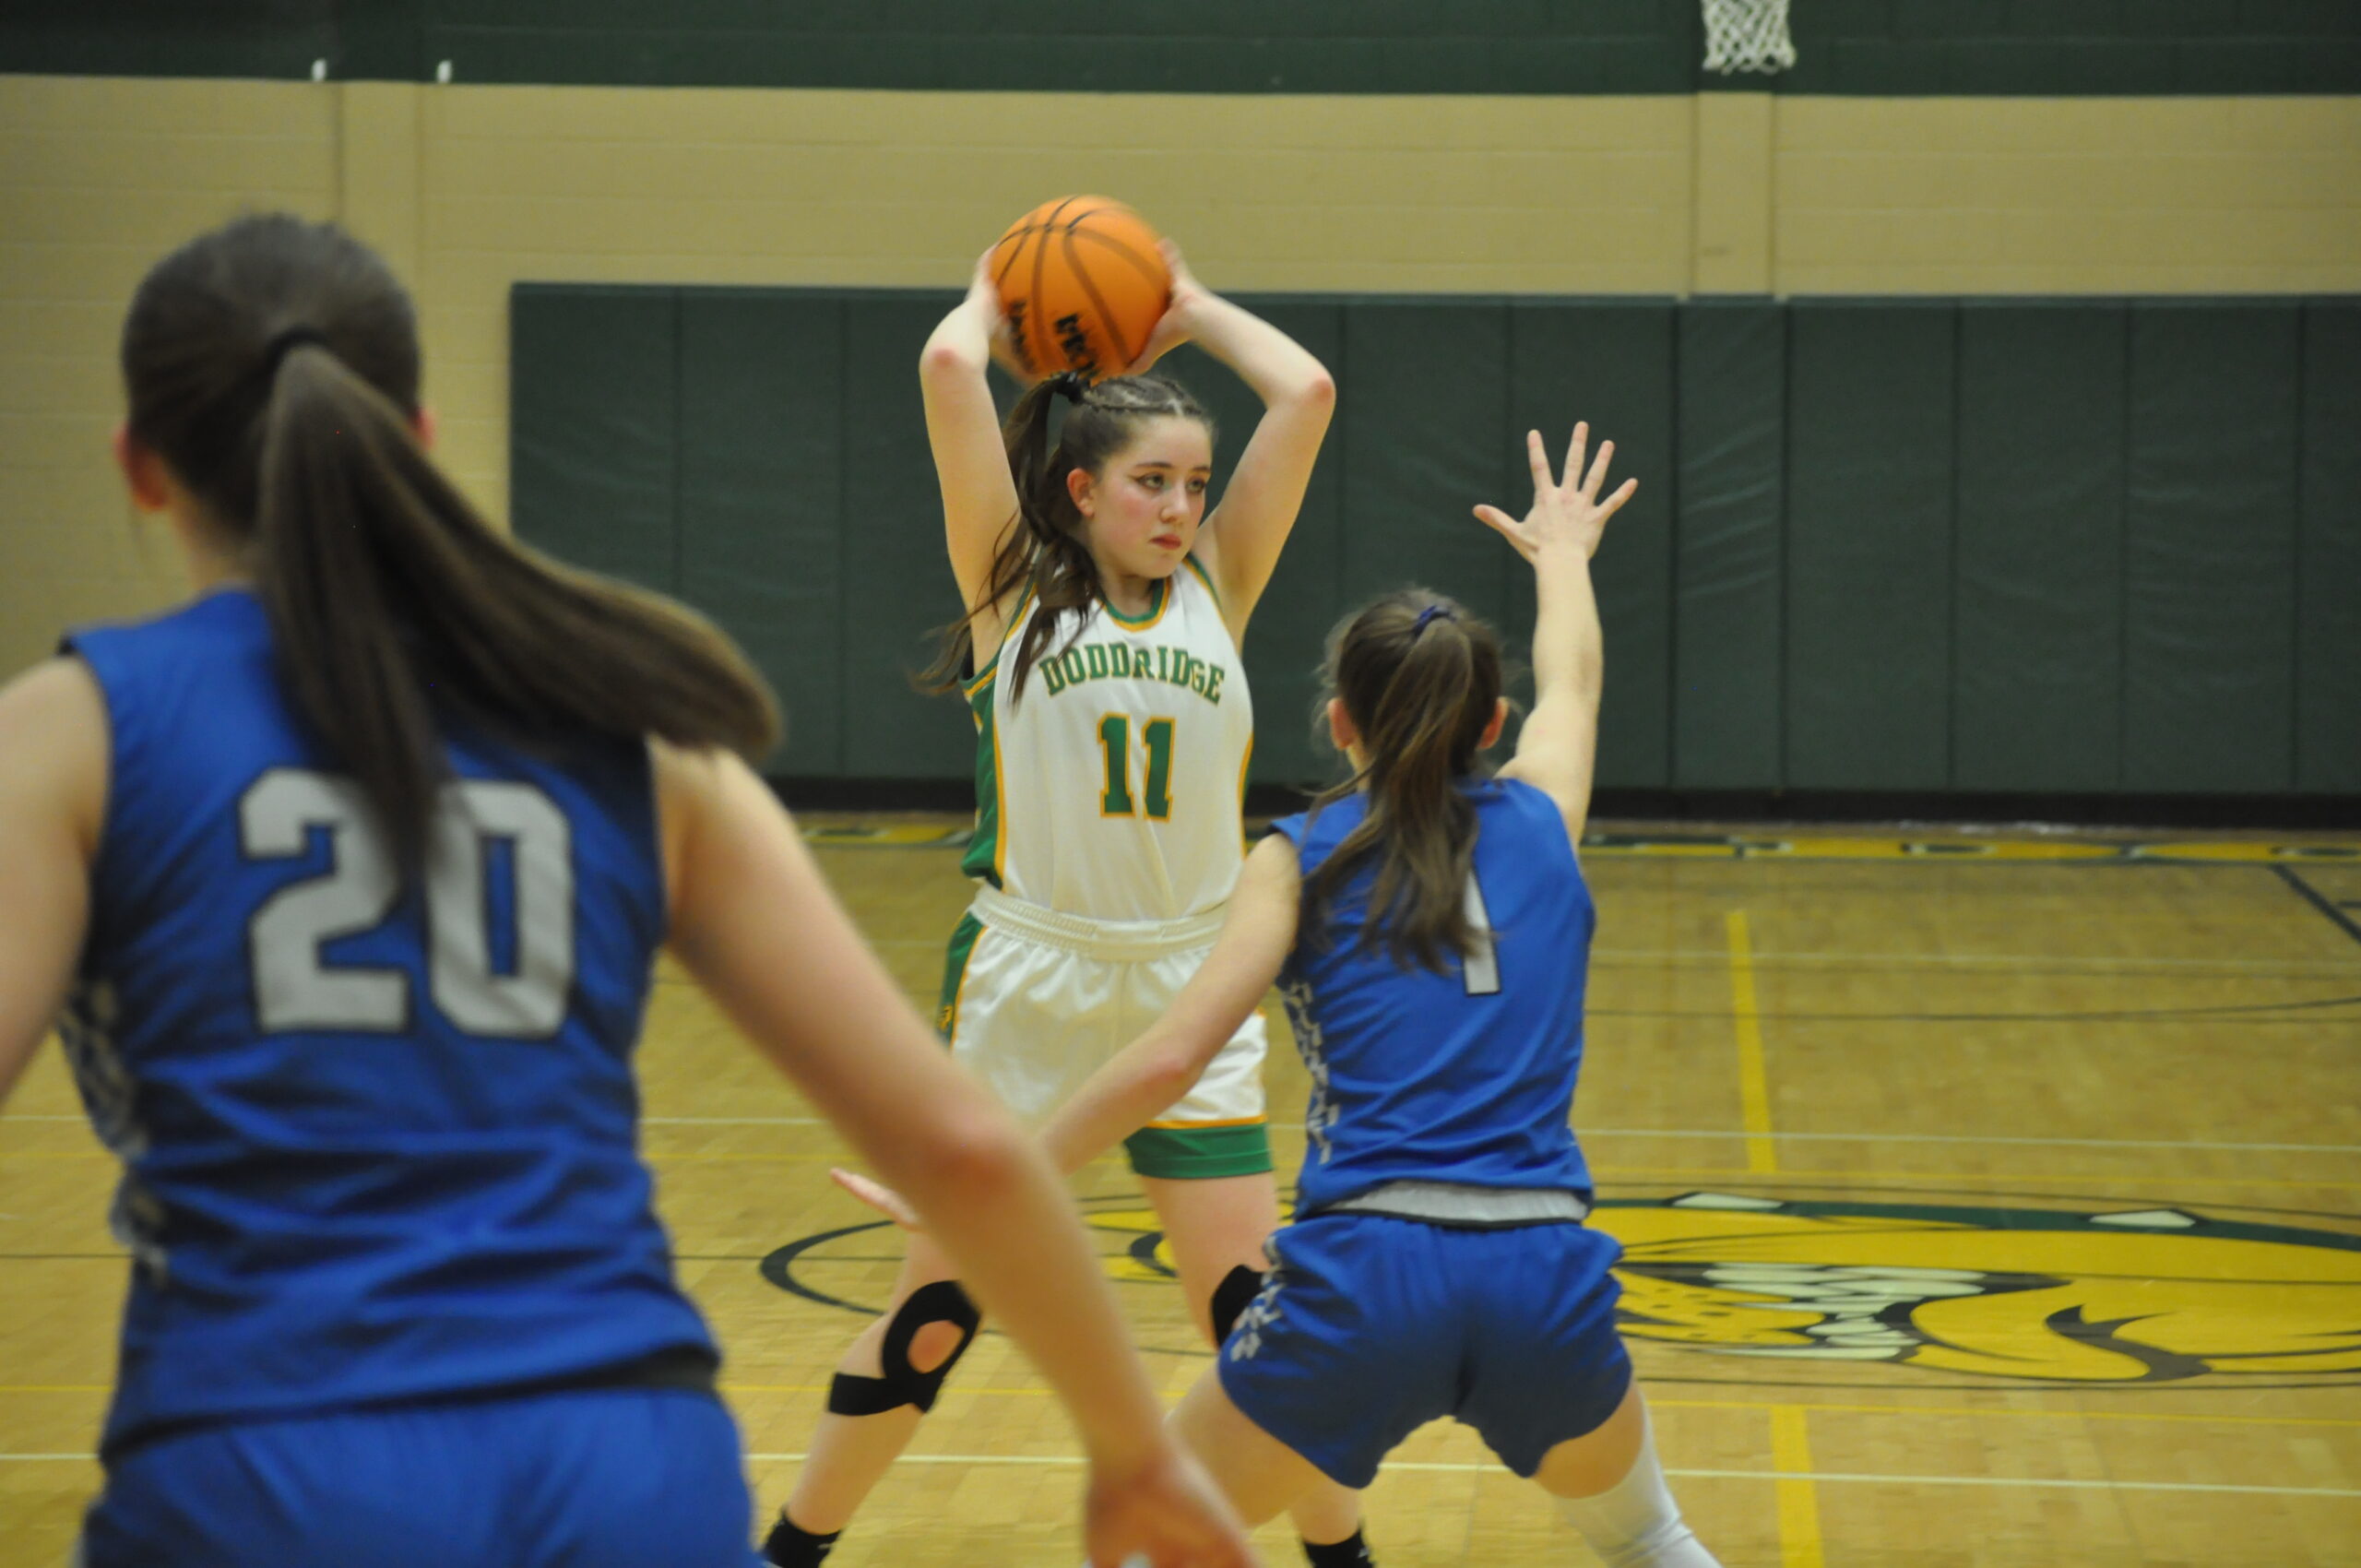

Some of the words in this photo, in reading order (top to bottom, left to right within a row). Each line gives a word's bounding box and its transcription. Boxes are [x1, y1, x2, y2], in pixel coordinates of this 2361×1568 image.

[1038, 641, 1225, 707] DODDRIDGE
[1097, 710, 1176, 823] 11
[239, 765, 575, 1039] 20
